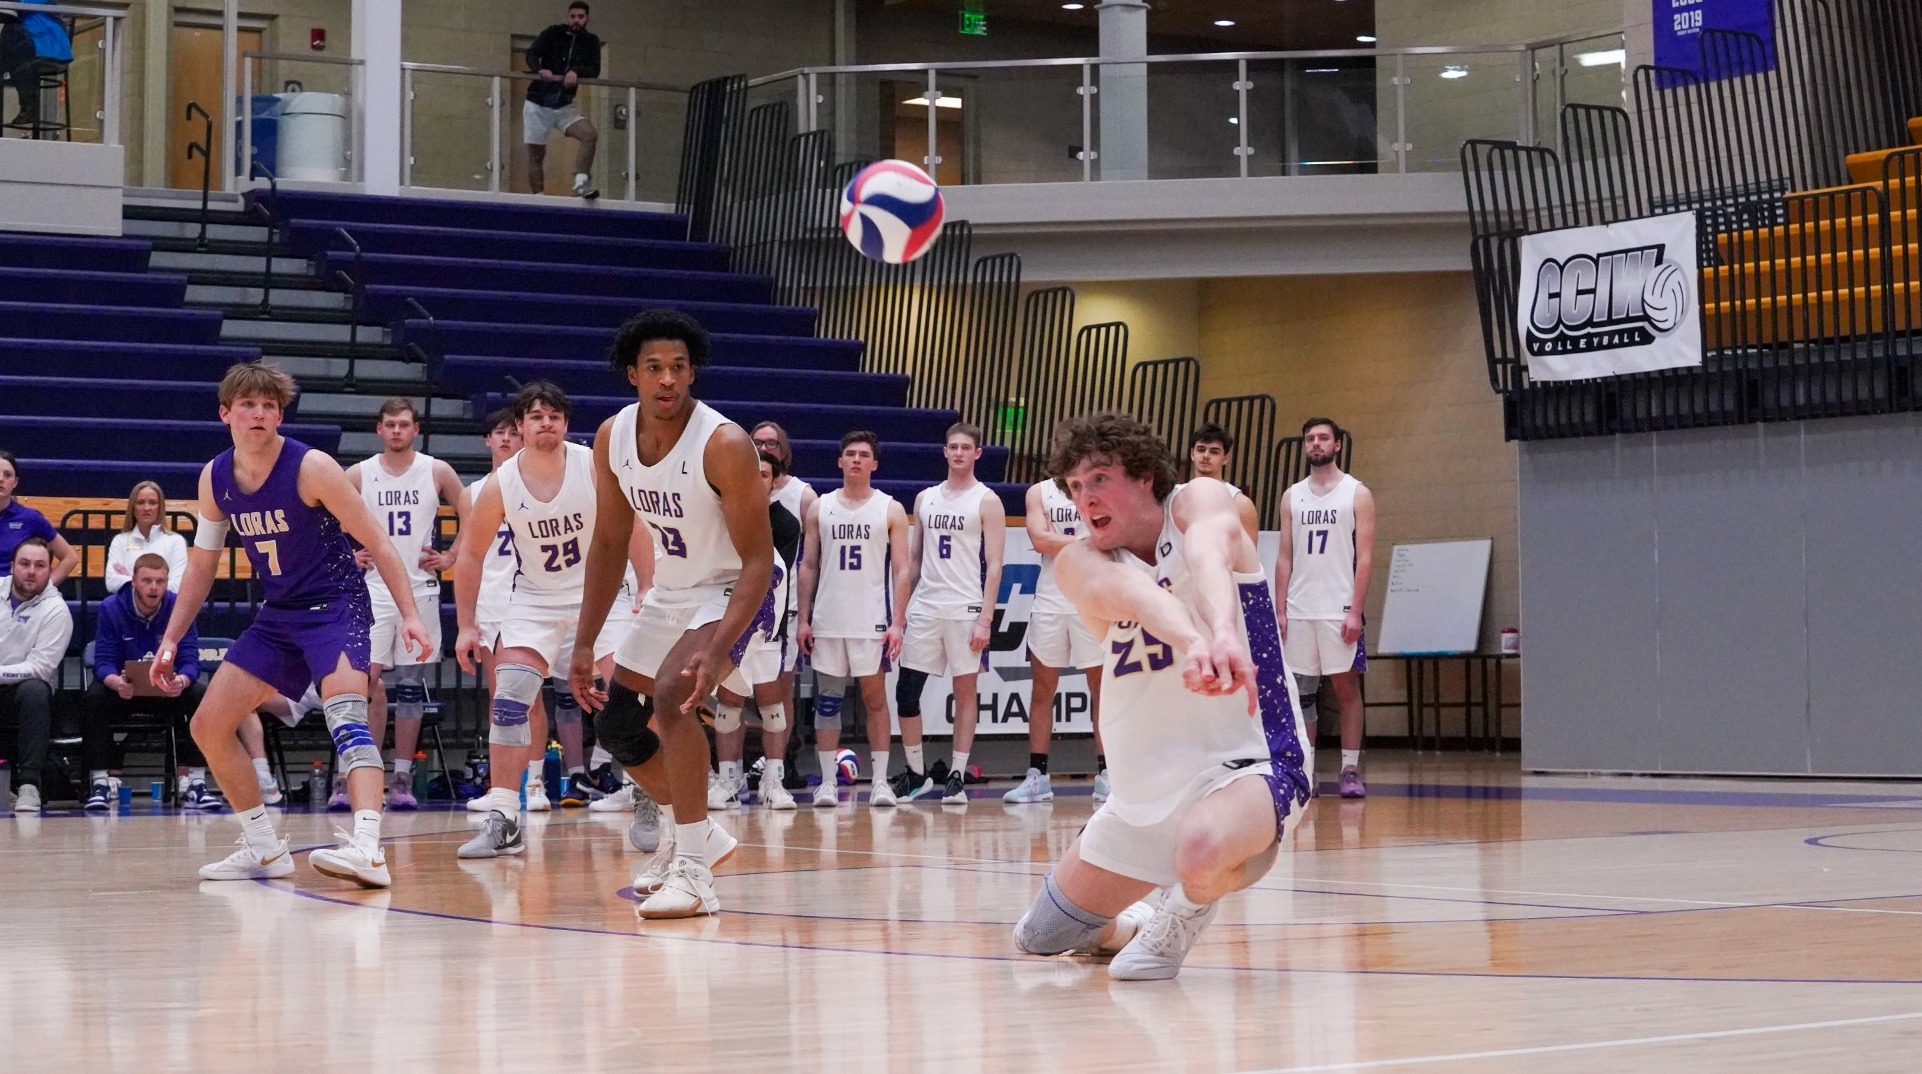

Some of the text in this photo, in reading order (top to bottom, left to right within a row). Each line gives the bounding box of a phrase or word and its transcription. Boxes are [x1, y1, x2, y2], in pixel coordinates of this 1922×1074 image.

[1673, 9, 1703, 31] 2019
[1531, 246, 1664, 332] CCIW
[1532, 331, 1641, 352] VOLLEYBALL
[378, 490, 419, 506] LORAS
[630, 486, 684, 518] LORAS
[230, 509, 290, 536] LORAS
[388, 511, 412, 537] 13
[528, 512, 584, 539] LORAS
[928, 514, 965, 531] LORAS
[1050, 507, 1082, 523] LORA
[1301, 509, 1337, 525] LORAS
[832, 524, 871, 540] LORAS
[1307, 529, 1329, 555] 17
[254, 539, 282, 576] 7
[540, 536, 582, 573] 29
[839, 545, 862, 571] 15
[938, 534, 952, 560] 6
[1111, 626, 1174, 678] 25
